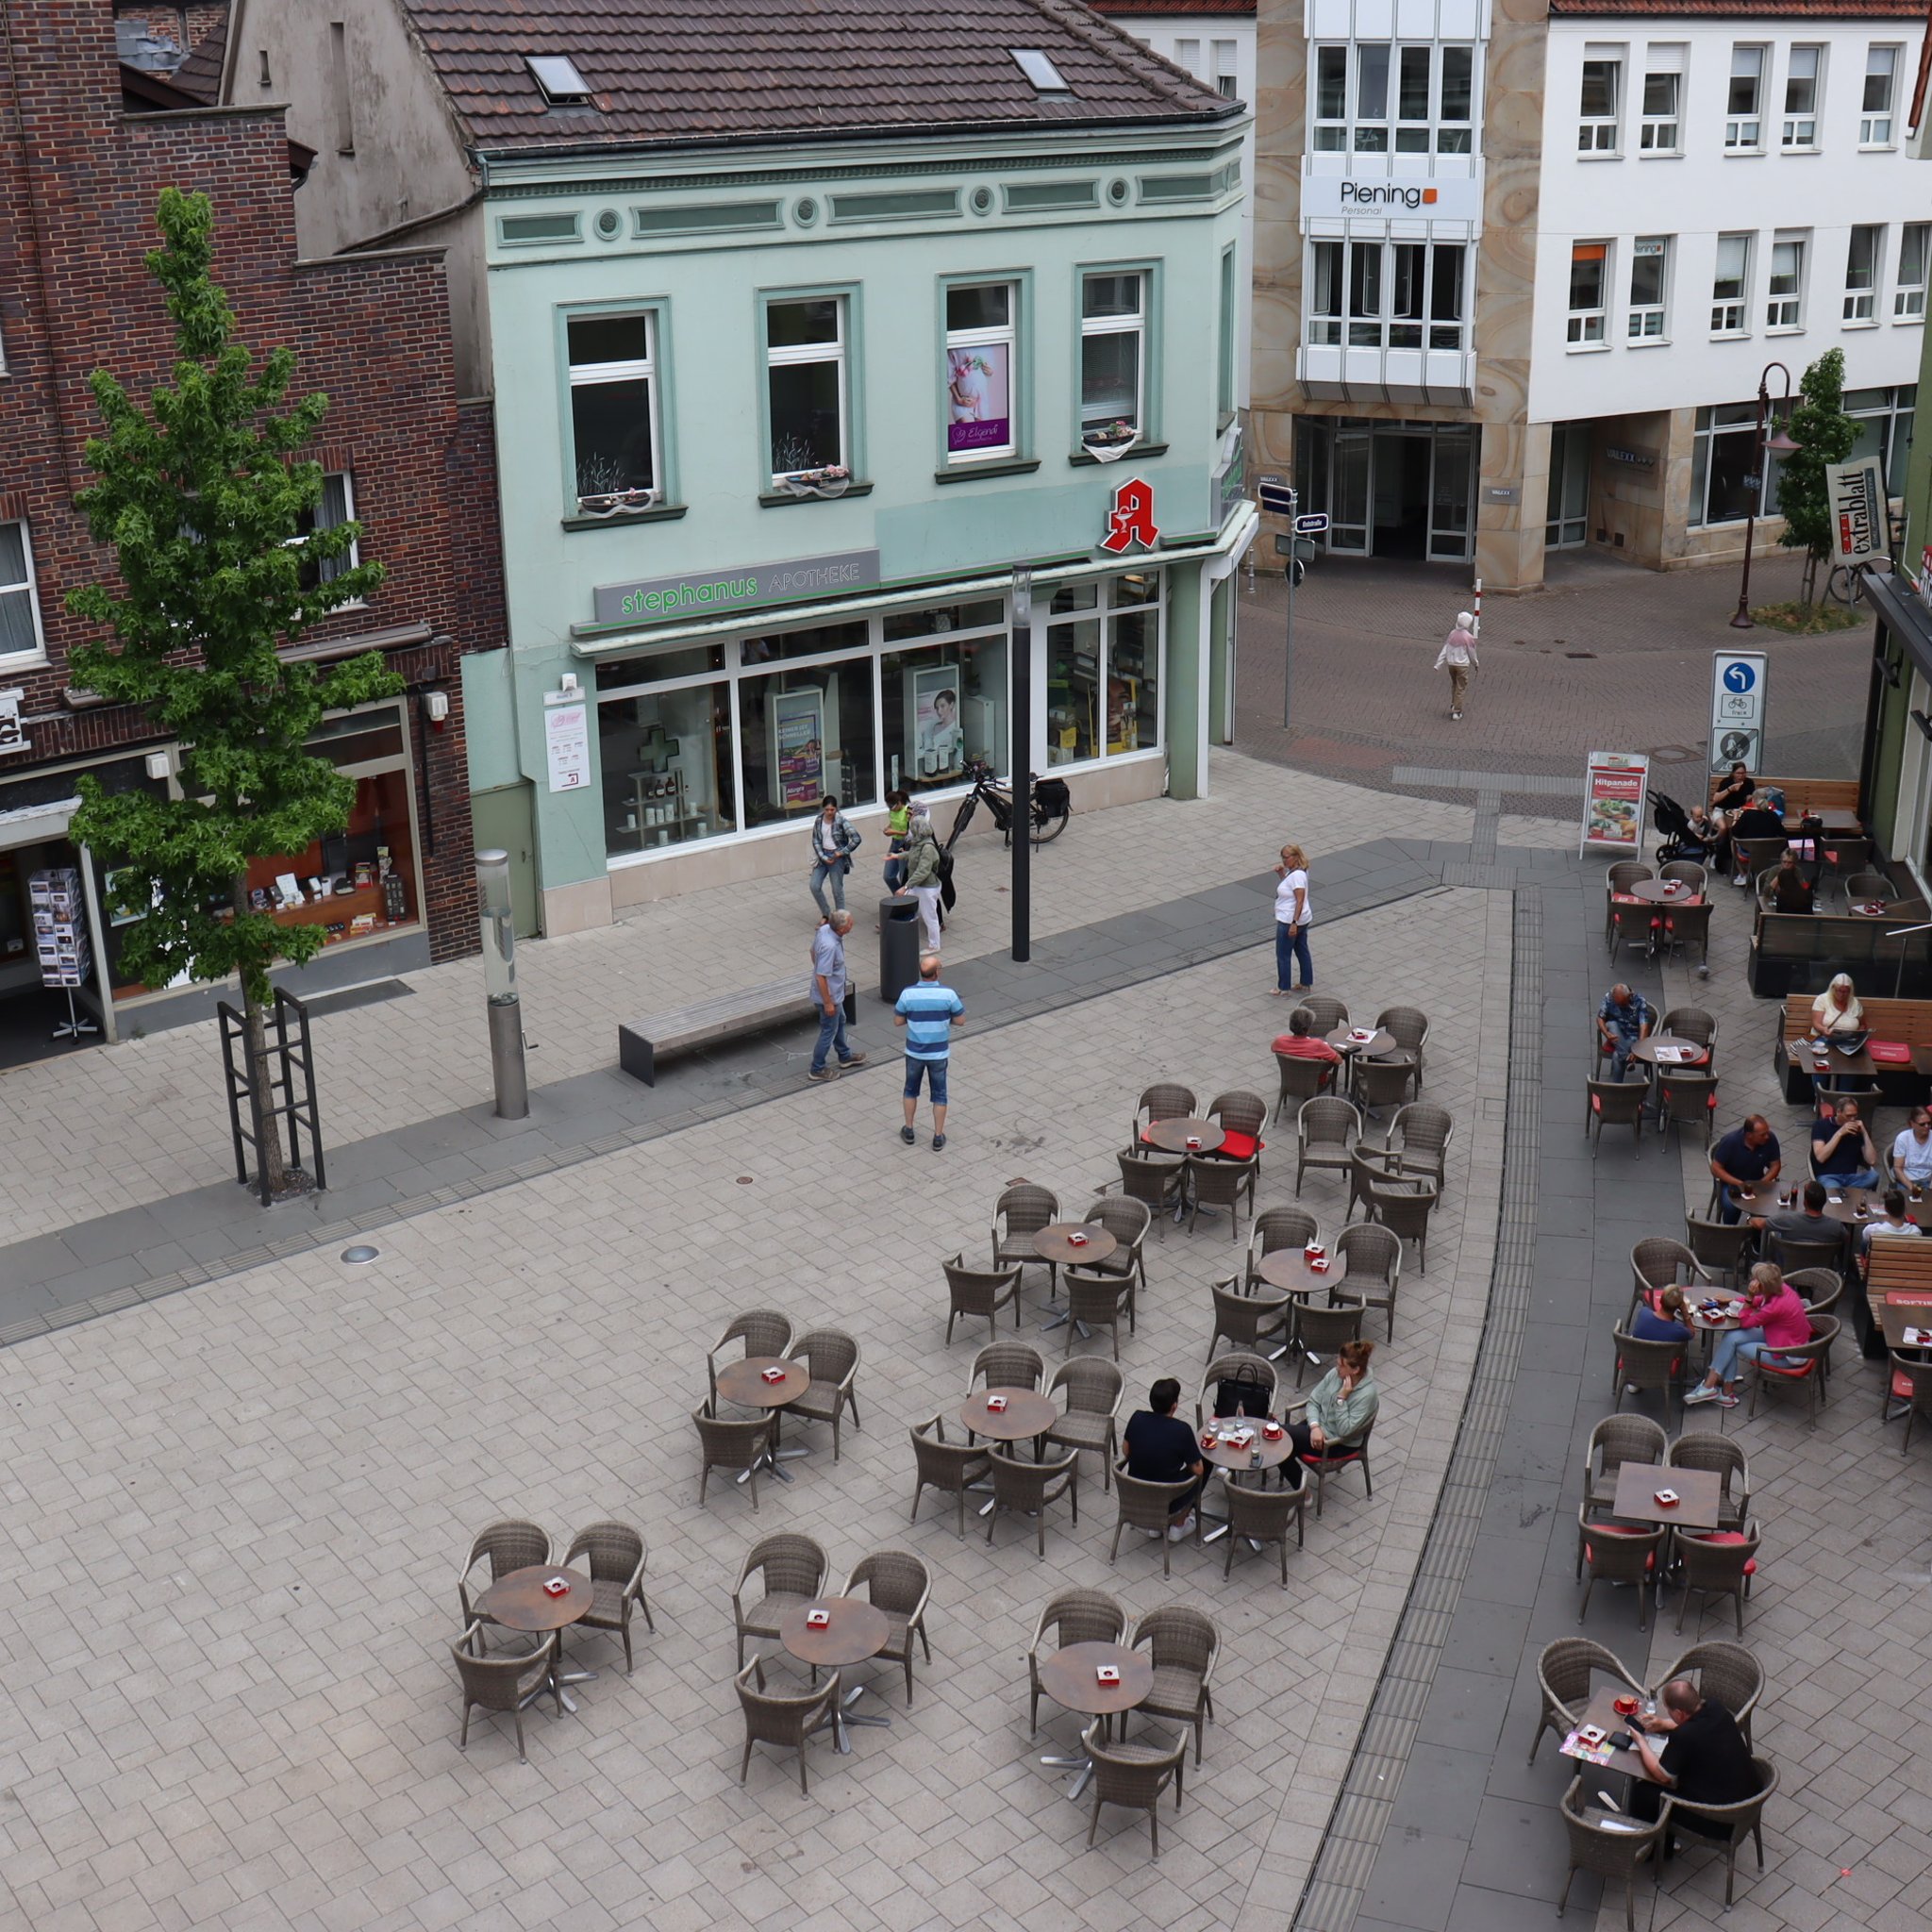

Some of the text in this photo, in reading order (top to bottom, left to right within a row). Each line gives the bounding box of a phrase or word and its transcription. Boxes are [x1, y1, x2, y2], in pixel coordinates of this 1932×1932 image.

[1341, 182, 1421, 208] Piening
[1341, 207, 1383, 215] Personal
[1836, 469, 1871, 555] extrablatt
[622, 563, 860, 615] stephanus APOTHEKE
[1594, 778, 1639, 789] Hitpanade
